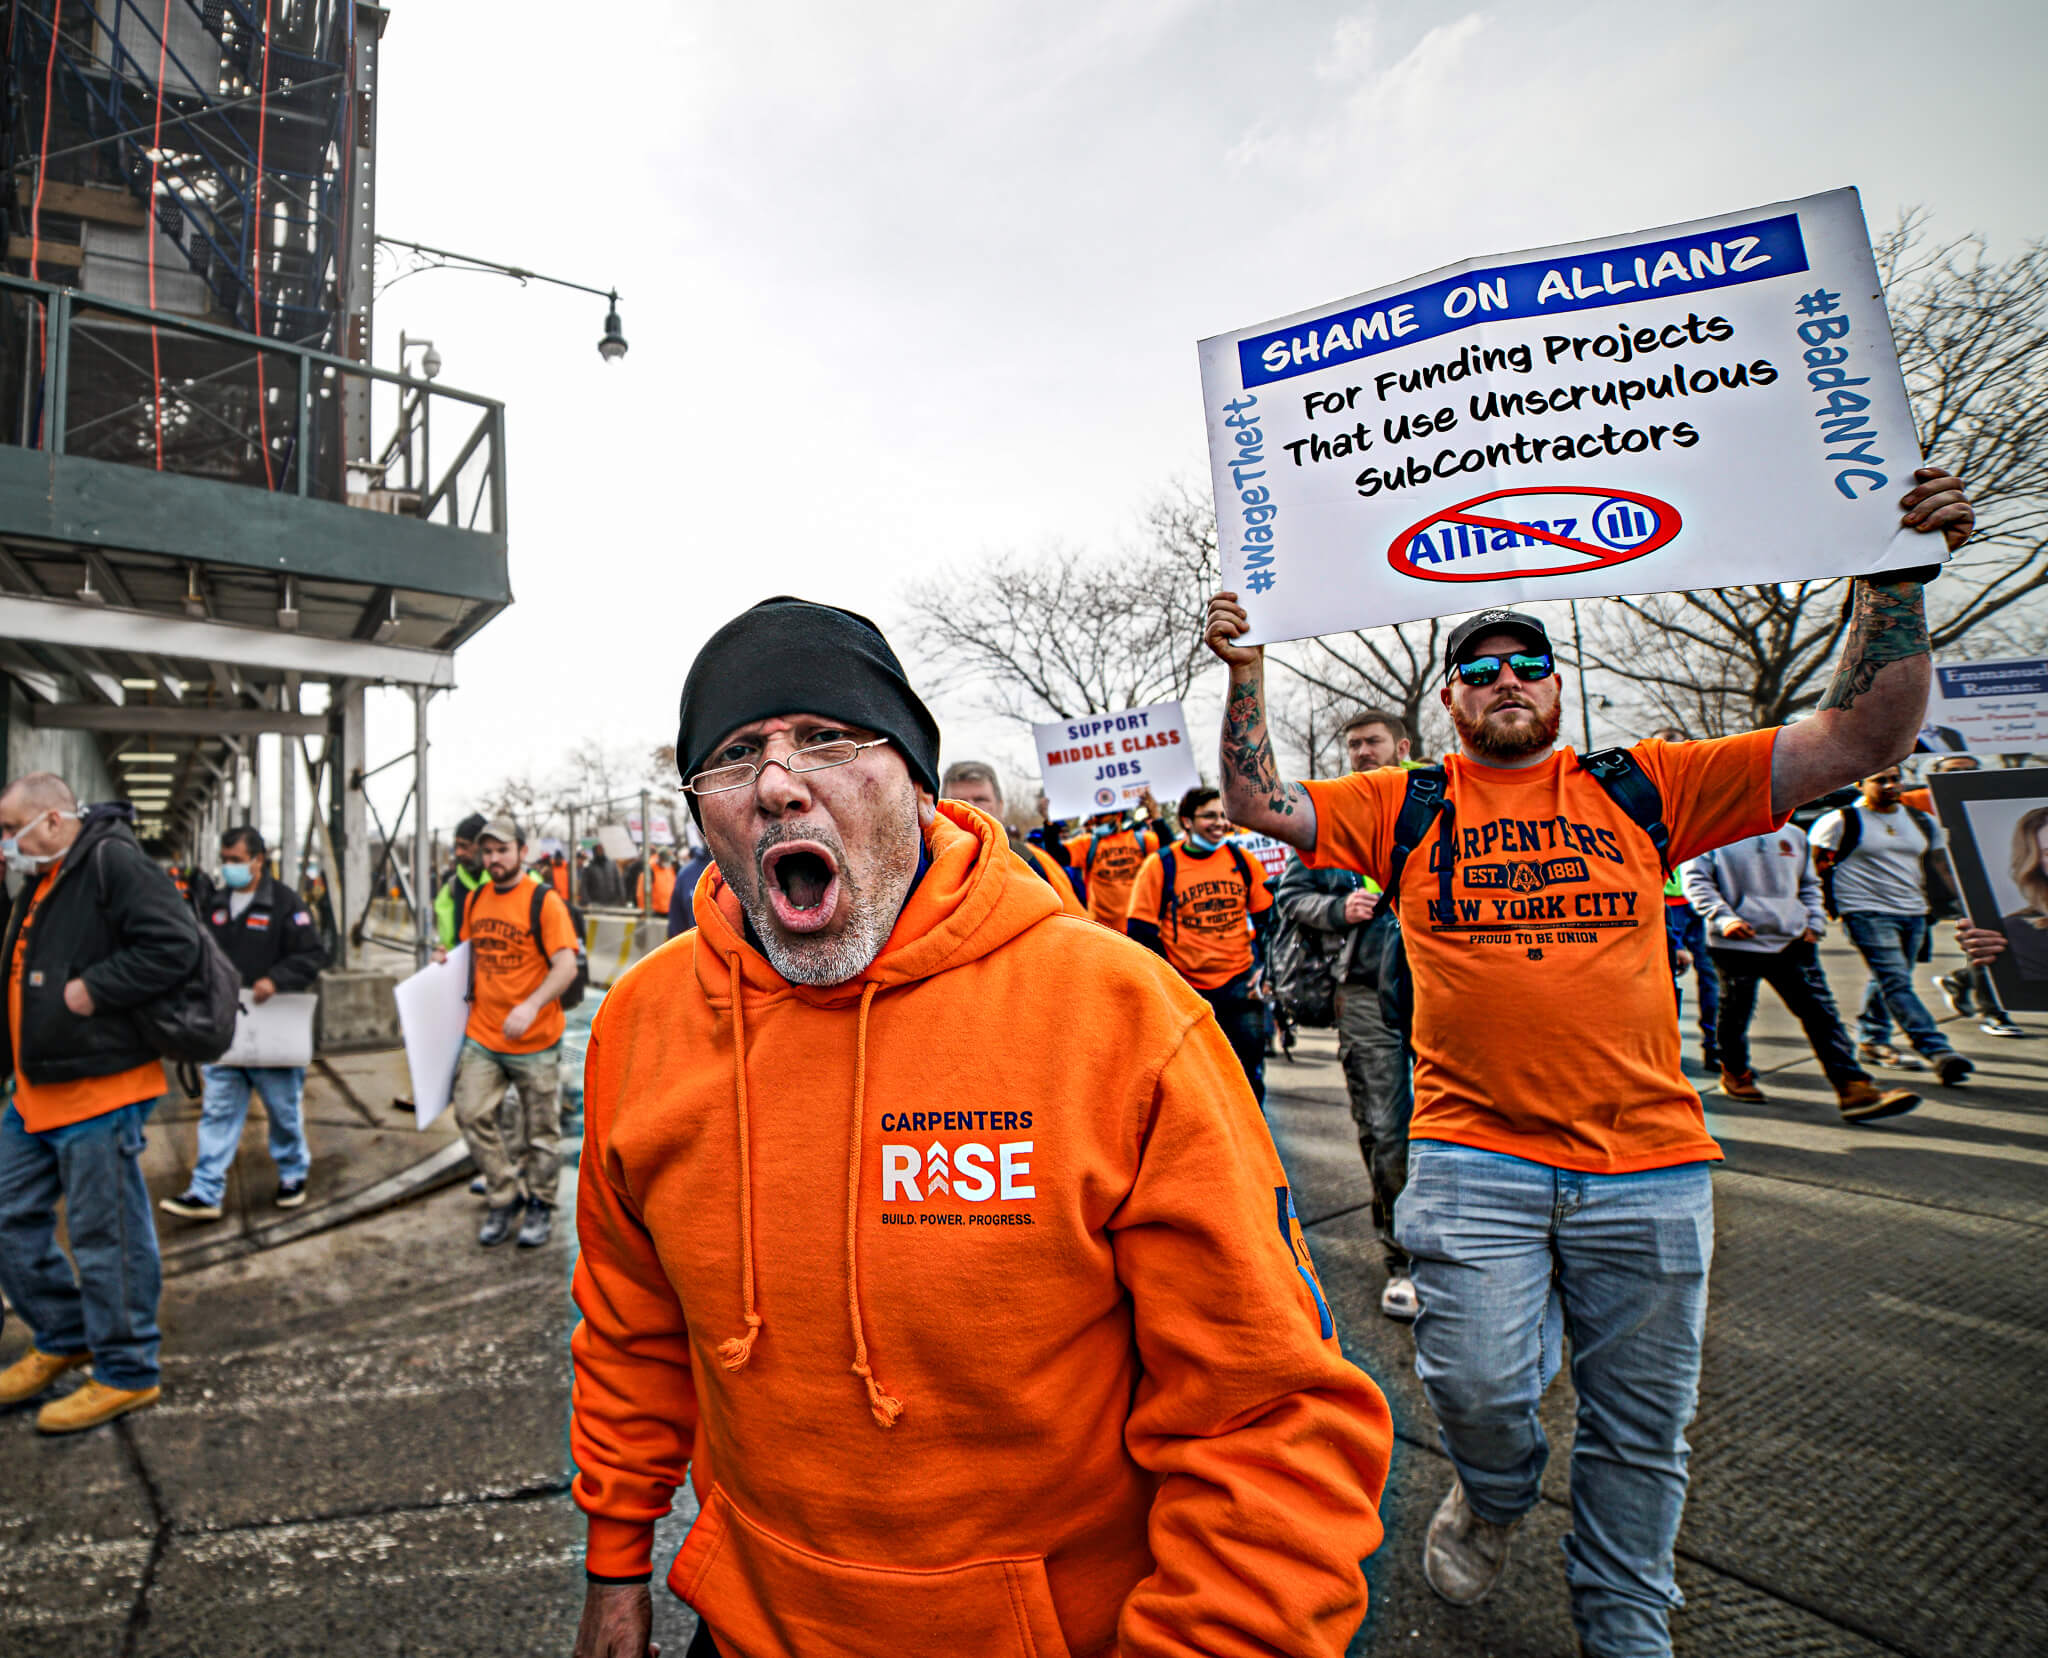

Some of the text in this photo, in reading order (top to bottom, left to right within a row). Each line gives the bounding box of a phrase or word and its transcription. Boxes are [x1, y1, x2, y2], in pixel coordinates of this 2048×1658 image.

[1262, 236, 1772, 373] SHAME ON ALLIANZ
[1303, 312, 1735, 420] For Funding Projects
[1283, 359, 1779, 467] That Use Unscrupulous
[1794, 287, 1889, 500] #Bad4NYC
[1355, 420, 1700, 498] SubContractors
[1222, 393, 1278, 595] #WageTheft
[1409, 517, 1582, 567] Allianz
[1047, 729, 1181, 767] MIDDLE CLASS
[1067, 712, 1150, 741] SUPPORT
[1095, 760, 1142, 781] JOBS
[1429, 816, 1625, 874] CARPENTERS
[1177, 880, 1248, 907] ARPENTER
[1468, 862, 1584, 884] EST. 1881
[1429, 891, 1639, 922] NW YORK CITY
[1470, 931, 1598, 944] PROUD TO BE UNION
[881, 1111, 1033, 1132] CARPENTERS
[882, 1140, 1036, 1201] RISE
[882, 1213, 1035, 1225] BUILD. POWER. PROGRESS.
